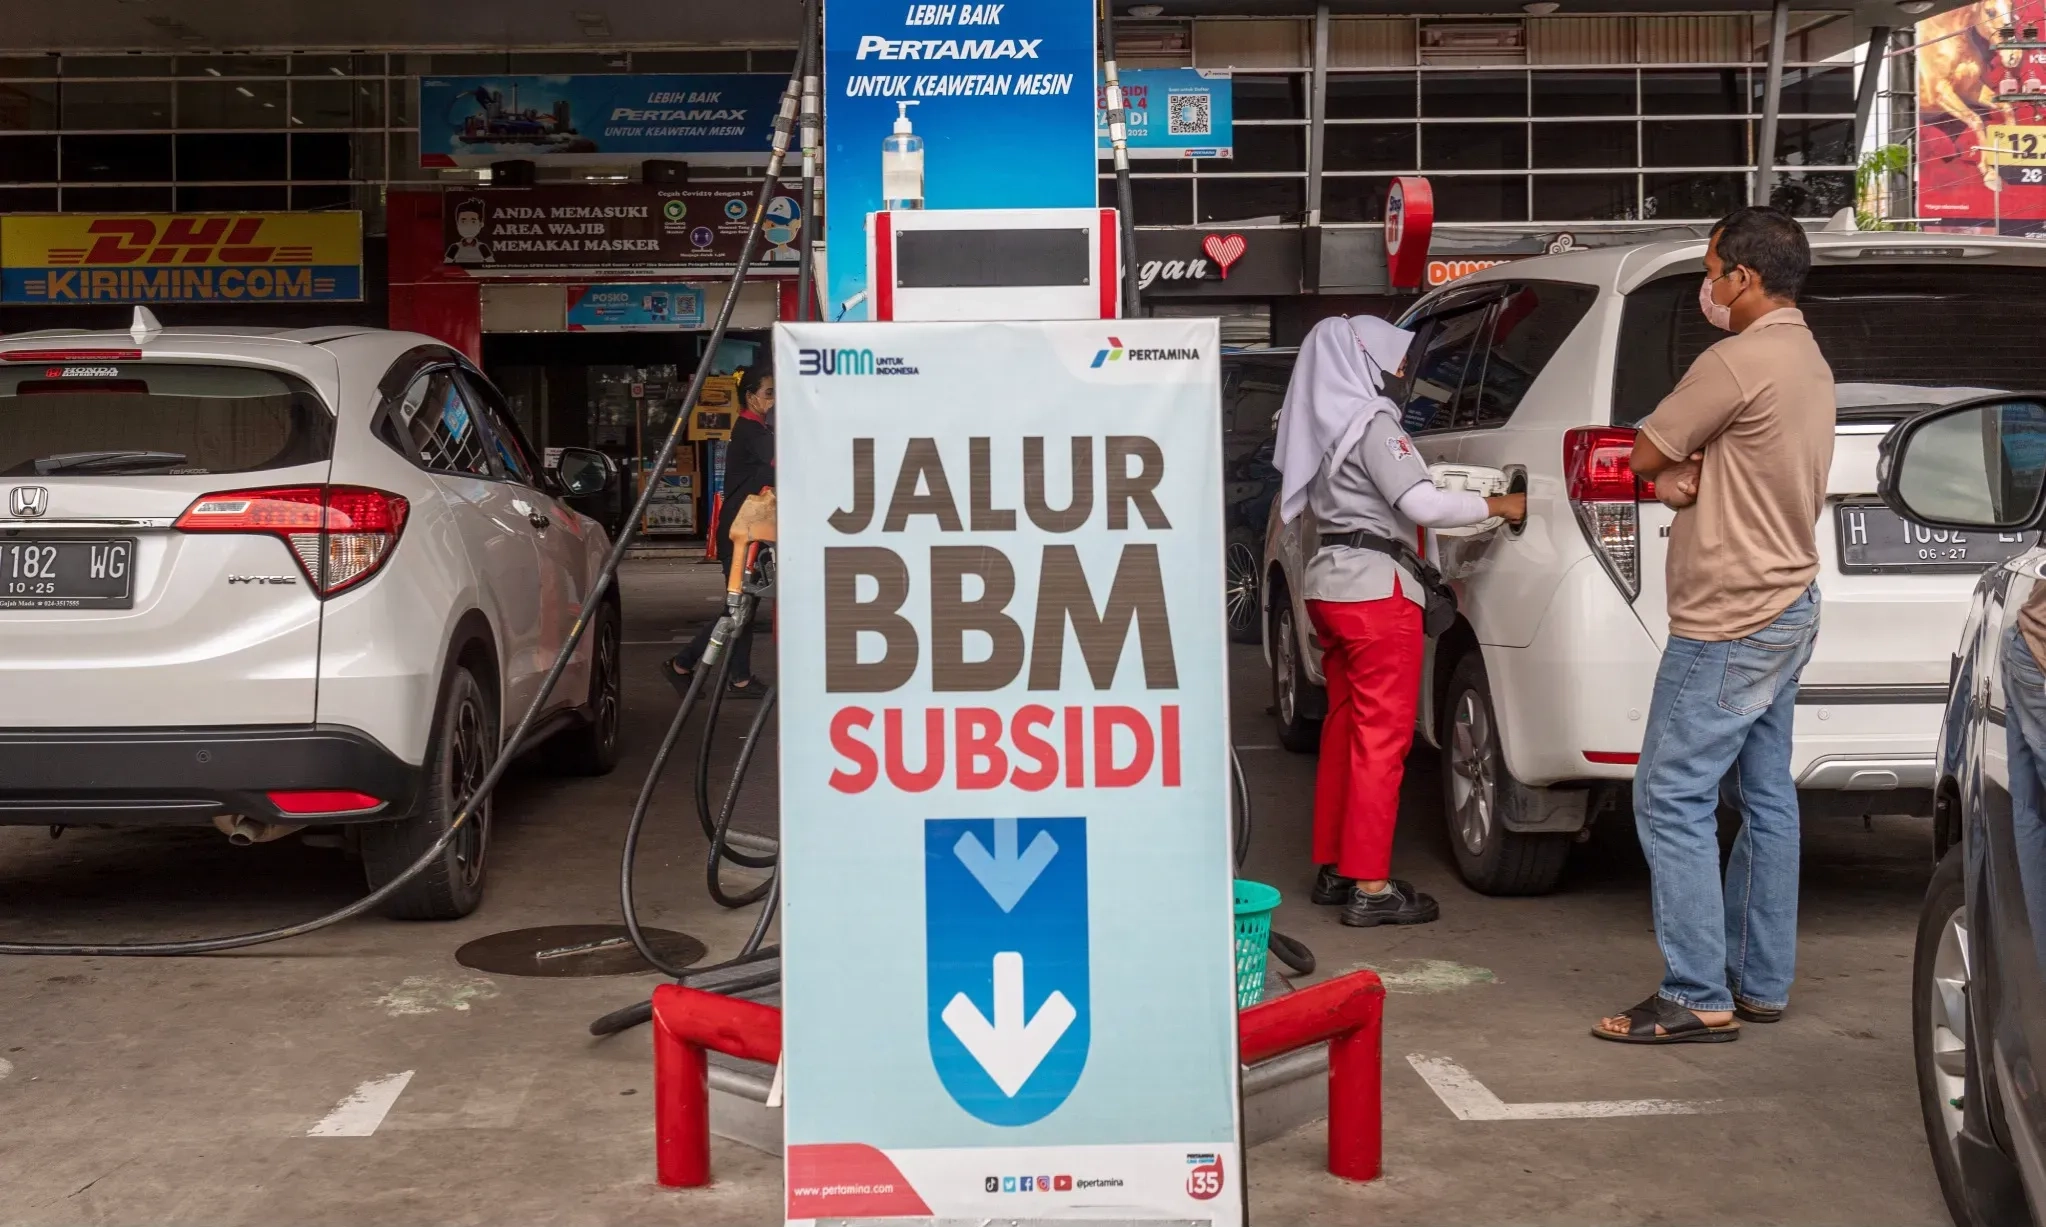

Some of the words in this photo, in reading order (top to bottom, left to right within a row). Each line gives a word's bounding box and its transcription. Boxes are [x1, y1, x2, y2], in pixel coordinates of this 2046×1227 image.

[906, 4, 956, 25] LEBIH
[958, 4, 1004, 25] BAIK
[856, 35, 1043, 60] PERTAMAX
[846, 75, 911, 97] UNTUK
[912, 74, 1012, 96] KEAWETAN
[1013, 73, 1073, 95] MESIN
[647, 92, 685, 104] LEBIH
[687, 92, 722, 103] BAIK
[1138, 97, 1148, 109] 4
[610, 108, 748, 121] PERTAMAX
[1130, 112, 1148, 126] DI
[604, 127, 645, 137] UNTUK
[646, 127, 707, 137] KEAWETAN
[708, 126, 746, 136] MESIN
[714, 190, 740, 198] dengan
[492, 207, 546, 219] ANDA
[551, 206, 649, 218] MEMASUKI
[492, 223, 544, 235] AREA
[548, 223, 606, 235] WAJIB
[84, 218, 278, 264] DHL
[492, 240, 580, 252] MEMAKAI
[584, 239, 660, 251] MASKER
[47, 269, 314, 300] KIRIMIN.COM
[592, 293, 629, 302] POSKO
[876, 357, 904, 365] UNTUK
[1129, 348, 1200, 361] PERTAMINA
[876, 367, 919, 375] INDONESIA
[827, 435, 1173, 534] JALUR
[1850, 512, 1867, 544] H
[0, 546, 57, 578] 182
[91, 546, 126, 579] WG
[824, 543, 1180, 693] BBM
[828, 704, 1181, 794] SUBSIDI
[1076, 1177, 1124, 1189] @pertamina
[1188, 1171, 1219, 1194] 135
